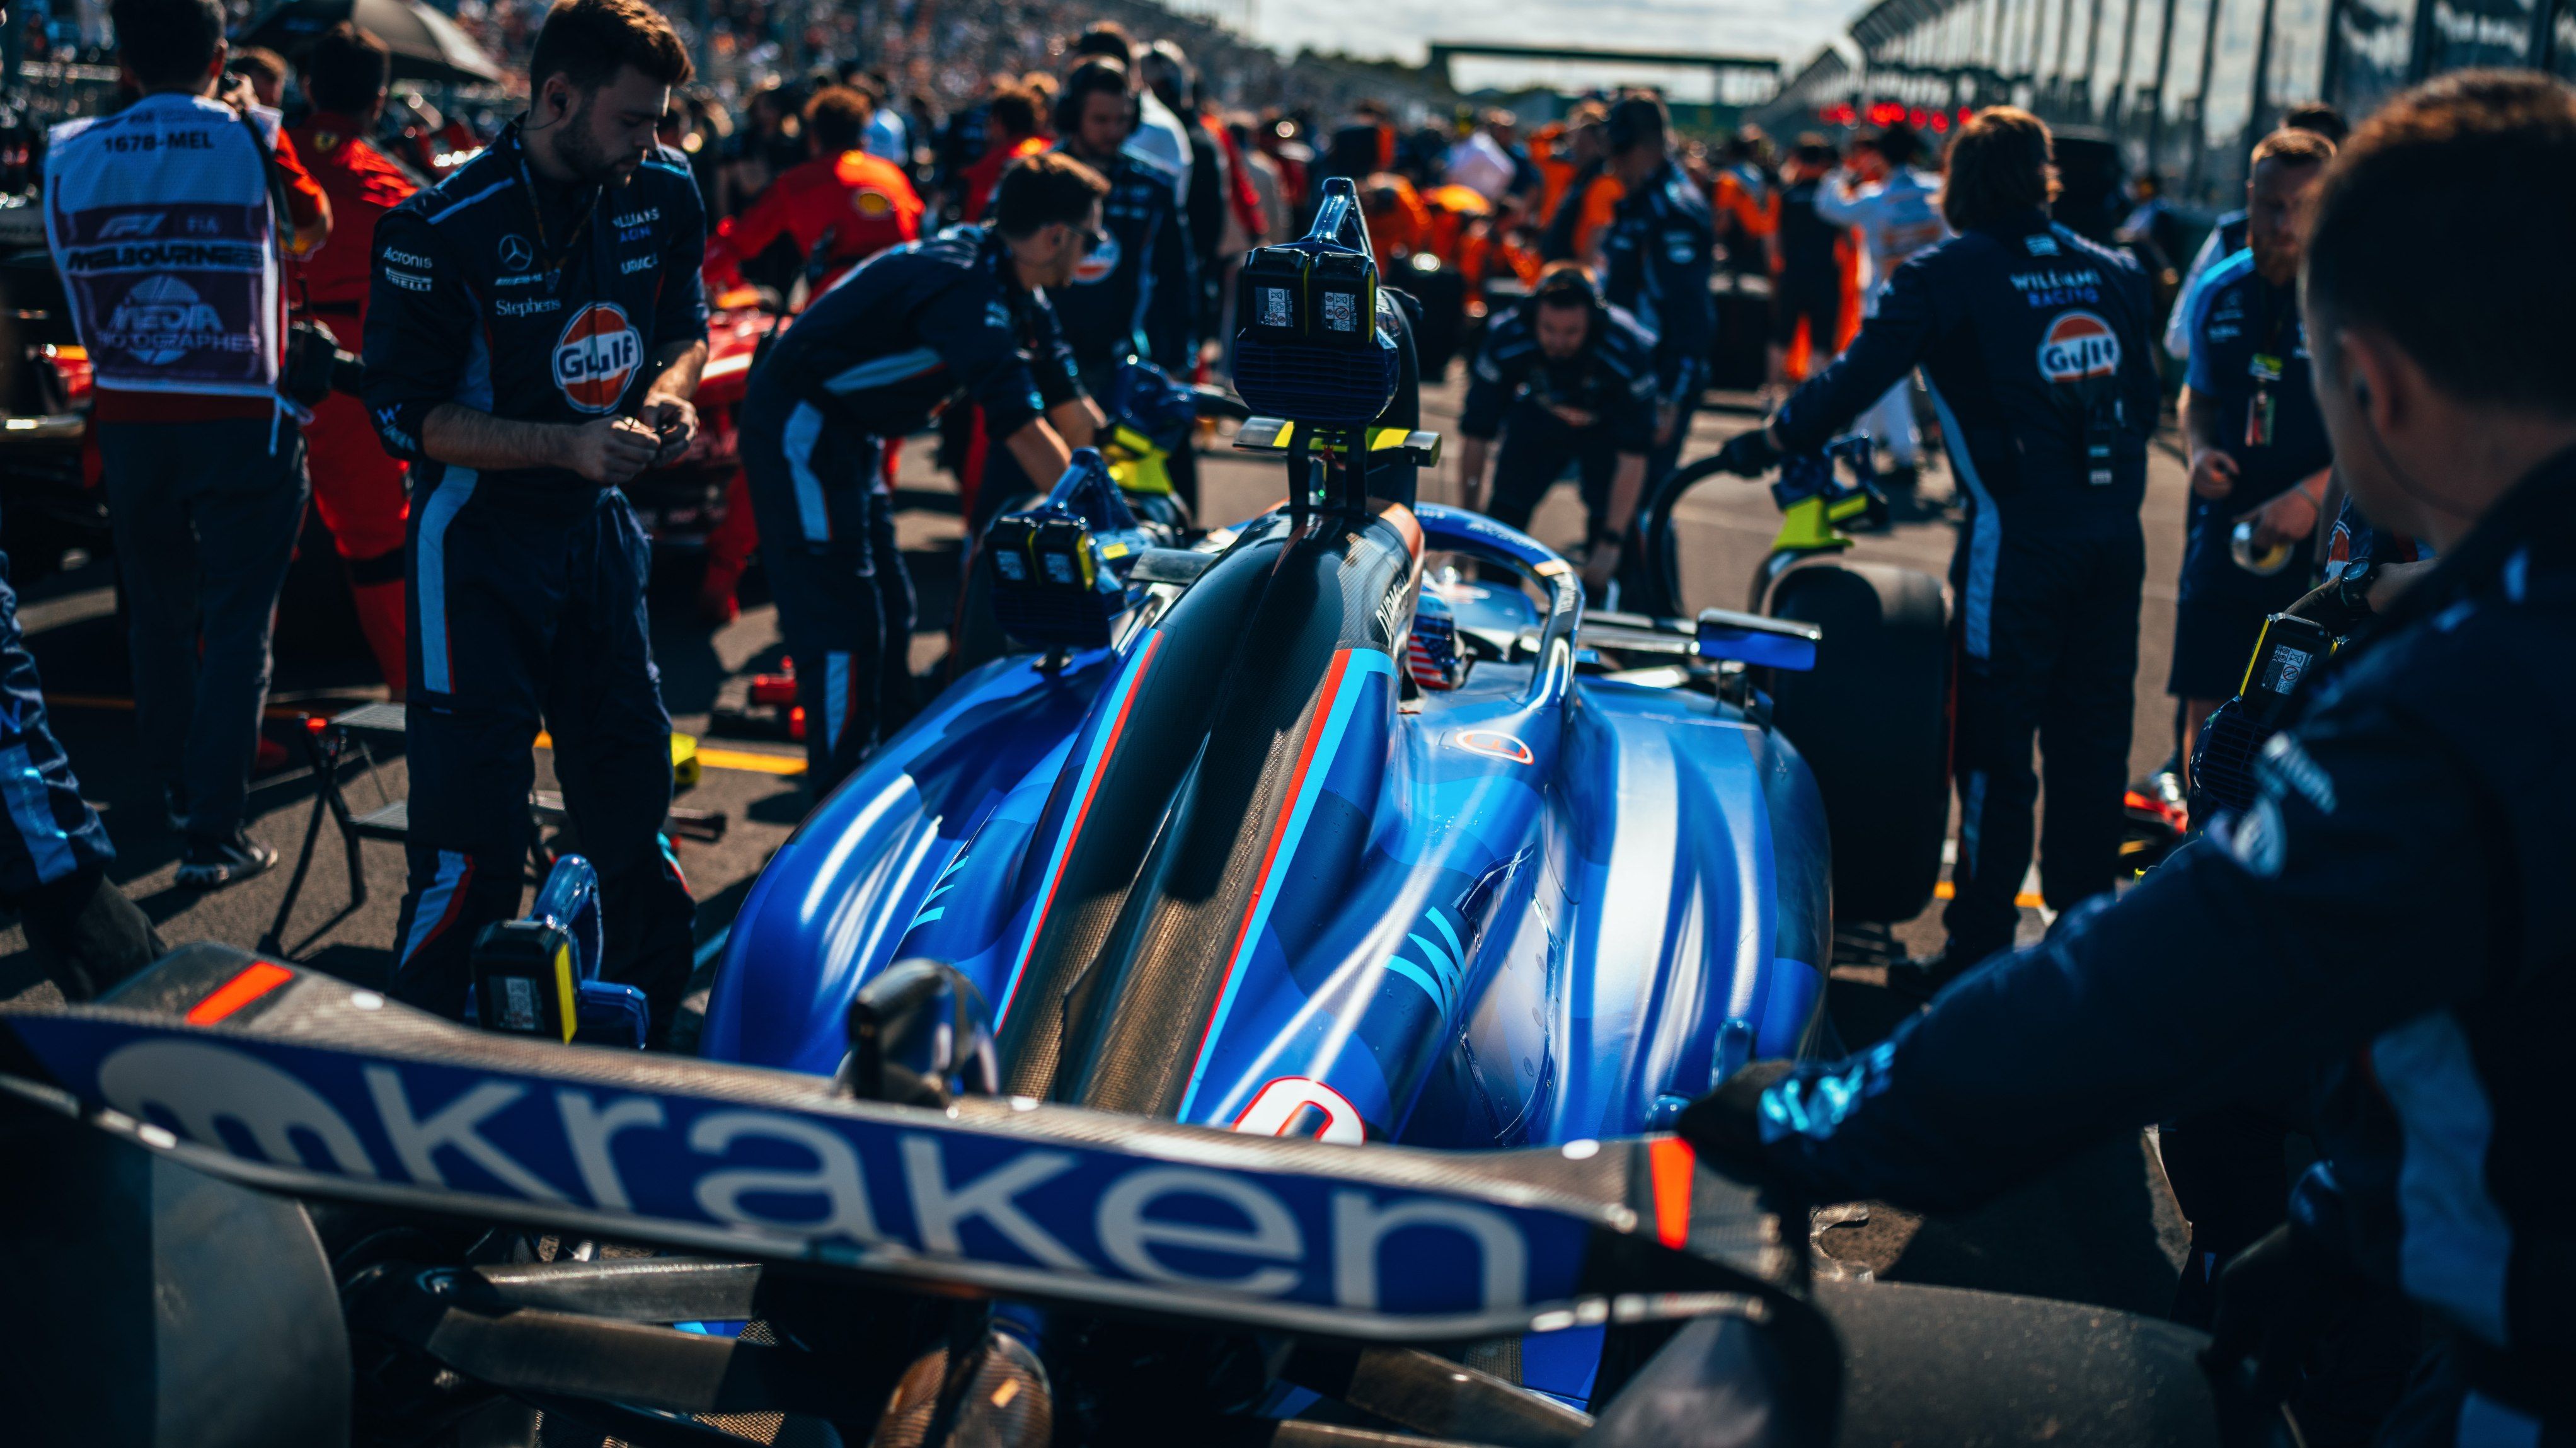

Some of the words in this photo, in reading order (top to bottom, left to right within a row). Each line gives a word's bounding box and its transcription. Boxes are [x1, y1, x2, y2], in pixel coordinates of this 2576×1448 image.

[104, 131, 213, 152] 1678-MEL
[383, 246, 433, 268] Acronis
[107, 304, 224, 333] MEDIA
[495, 297, 561, 317] Stephens
[558, 335, 633, 378] Gulf
[2045, 338, 2115, 372] Gulf
[360, 1062, 1529, 1313] kraken
